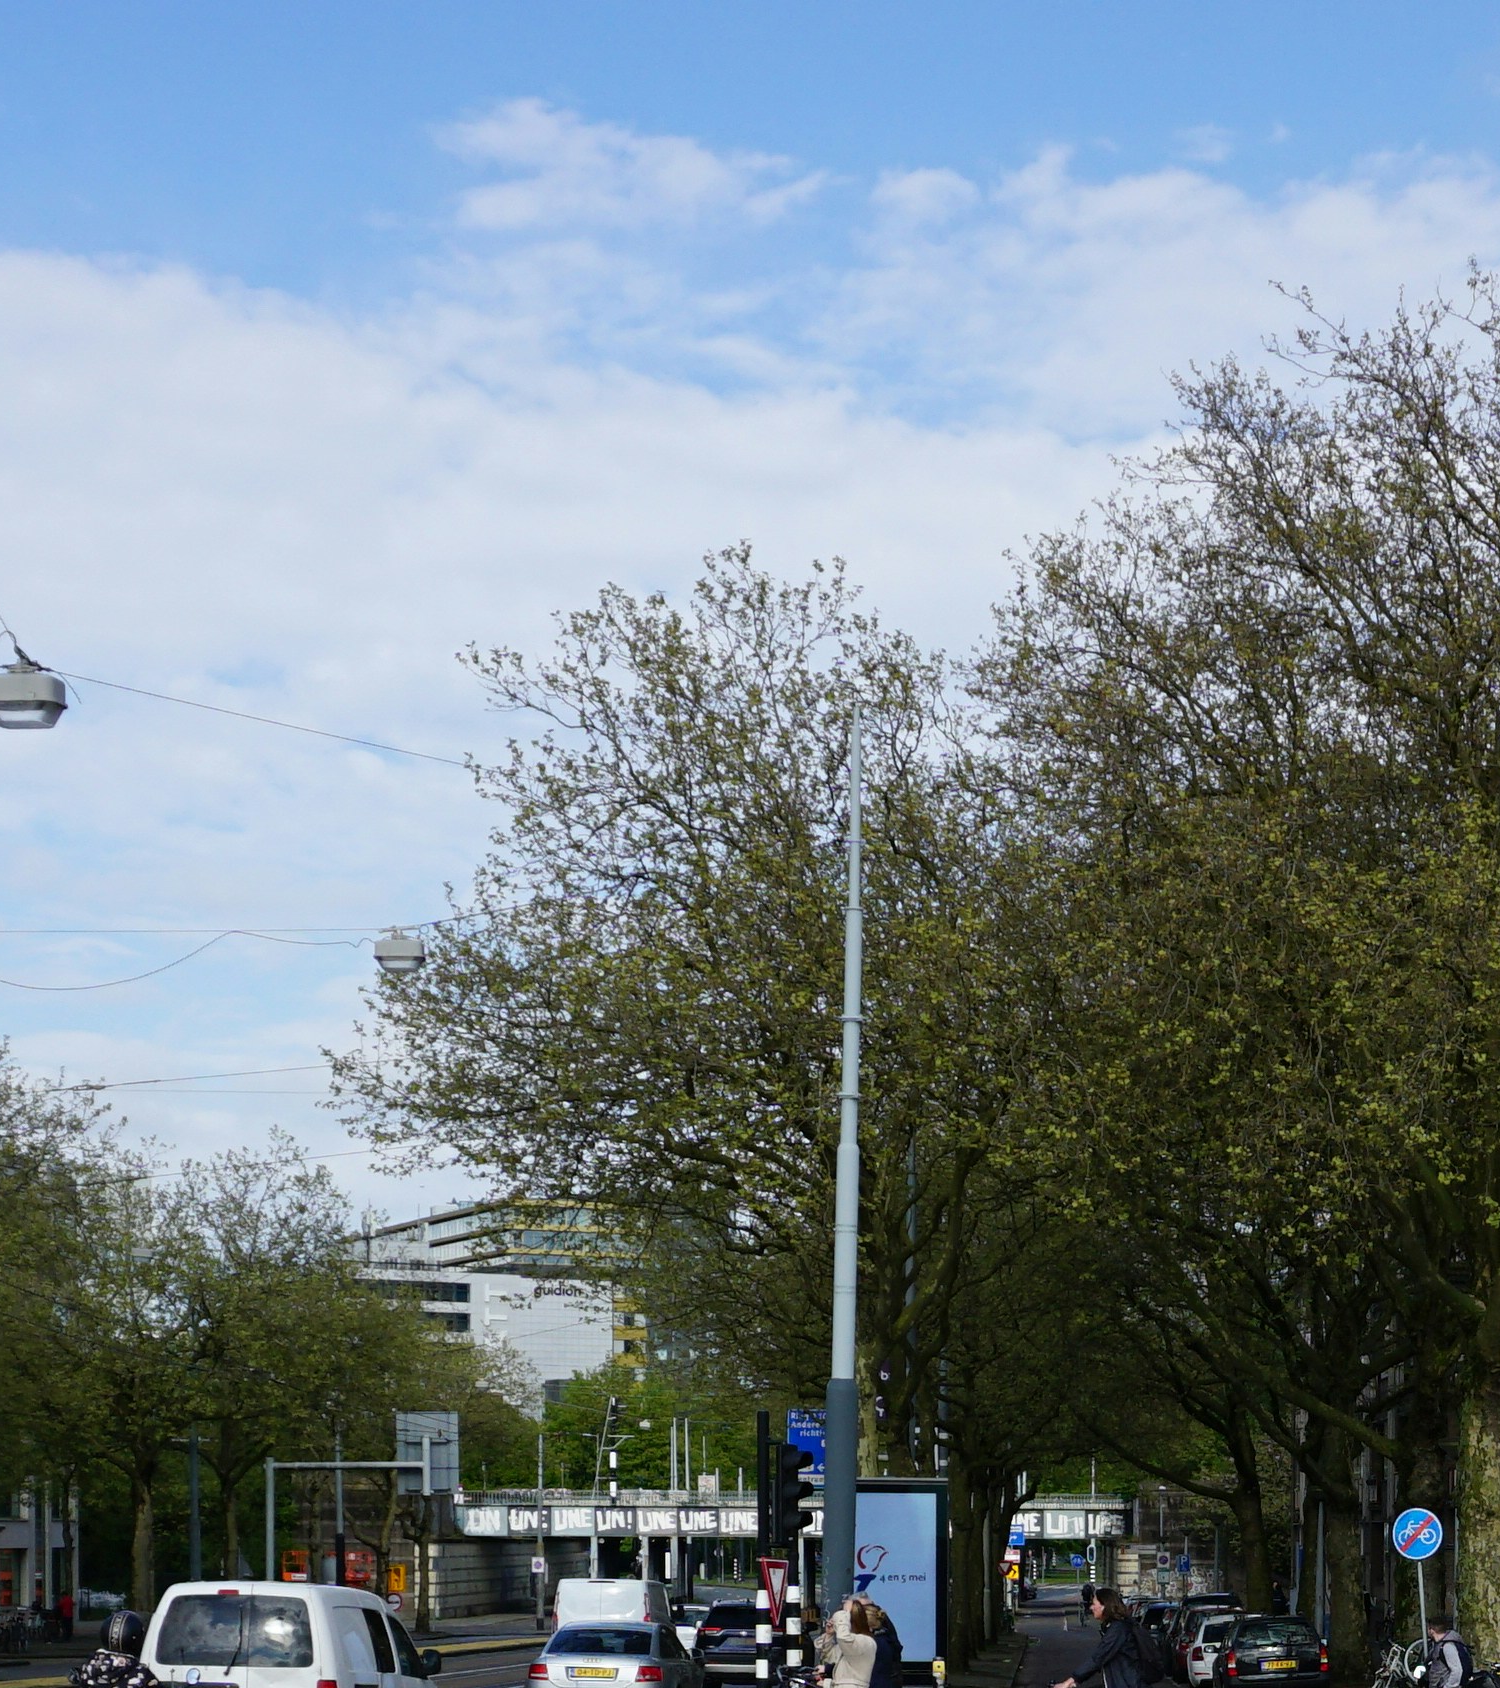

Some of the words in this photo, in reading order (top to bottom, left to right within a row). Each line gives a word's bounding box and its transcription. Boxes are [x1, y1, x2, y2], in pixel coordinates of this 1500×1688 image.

[534, 1281, 581, 1298] guidion
[554, 1508, 594, 1532] UNE
[680, 1510, 718, 1531] UNE
[879, 1574, 886, 1583] 4
[901, 1575, 907, 1583] 5
[908, 1573, 927, 1582] mei
